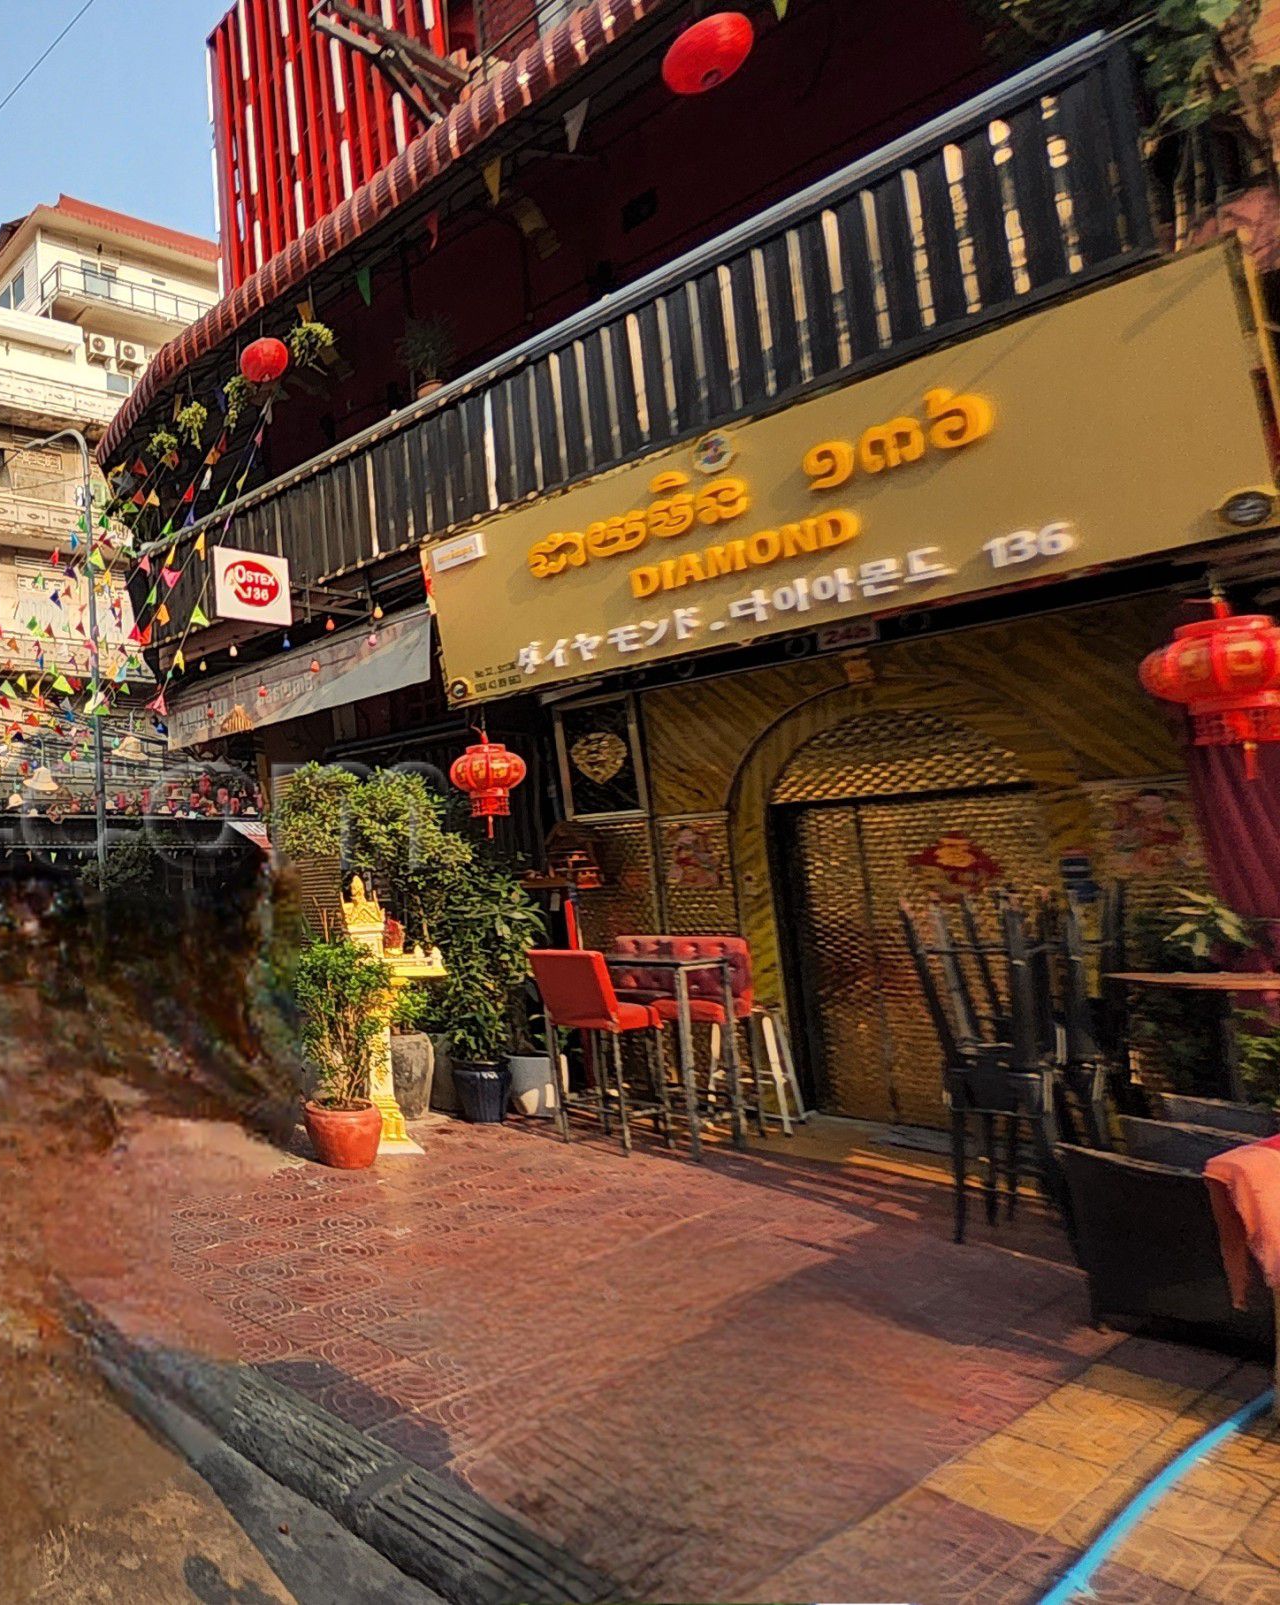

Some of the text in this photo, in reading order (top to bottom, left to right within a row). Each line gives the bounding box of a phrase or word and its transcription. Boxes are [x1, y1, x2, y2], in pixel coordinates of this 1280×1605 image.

[628, 508, 862, 599] DIAMOND
[728, 545, 959, 622] 다이아몬드
[982, 521, 1075, 568] 136
